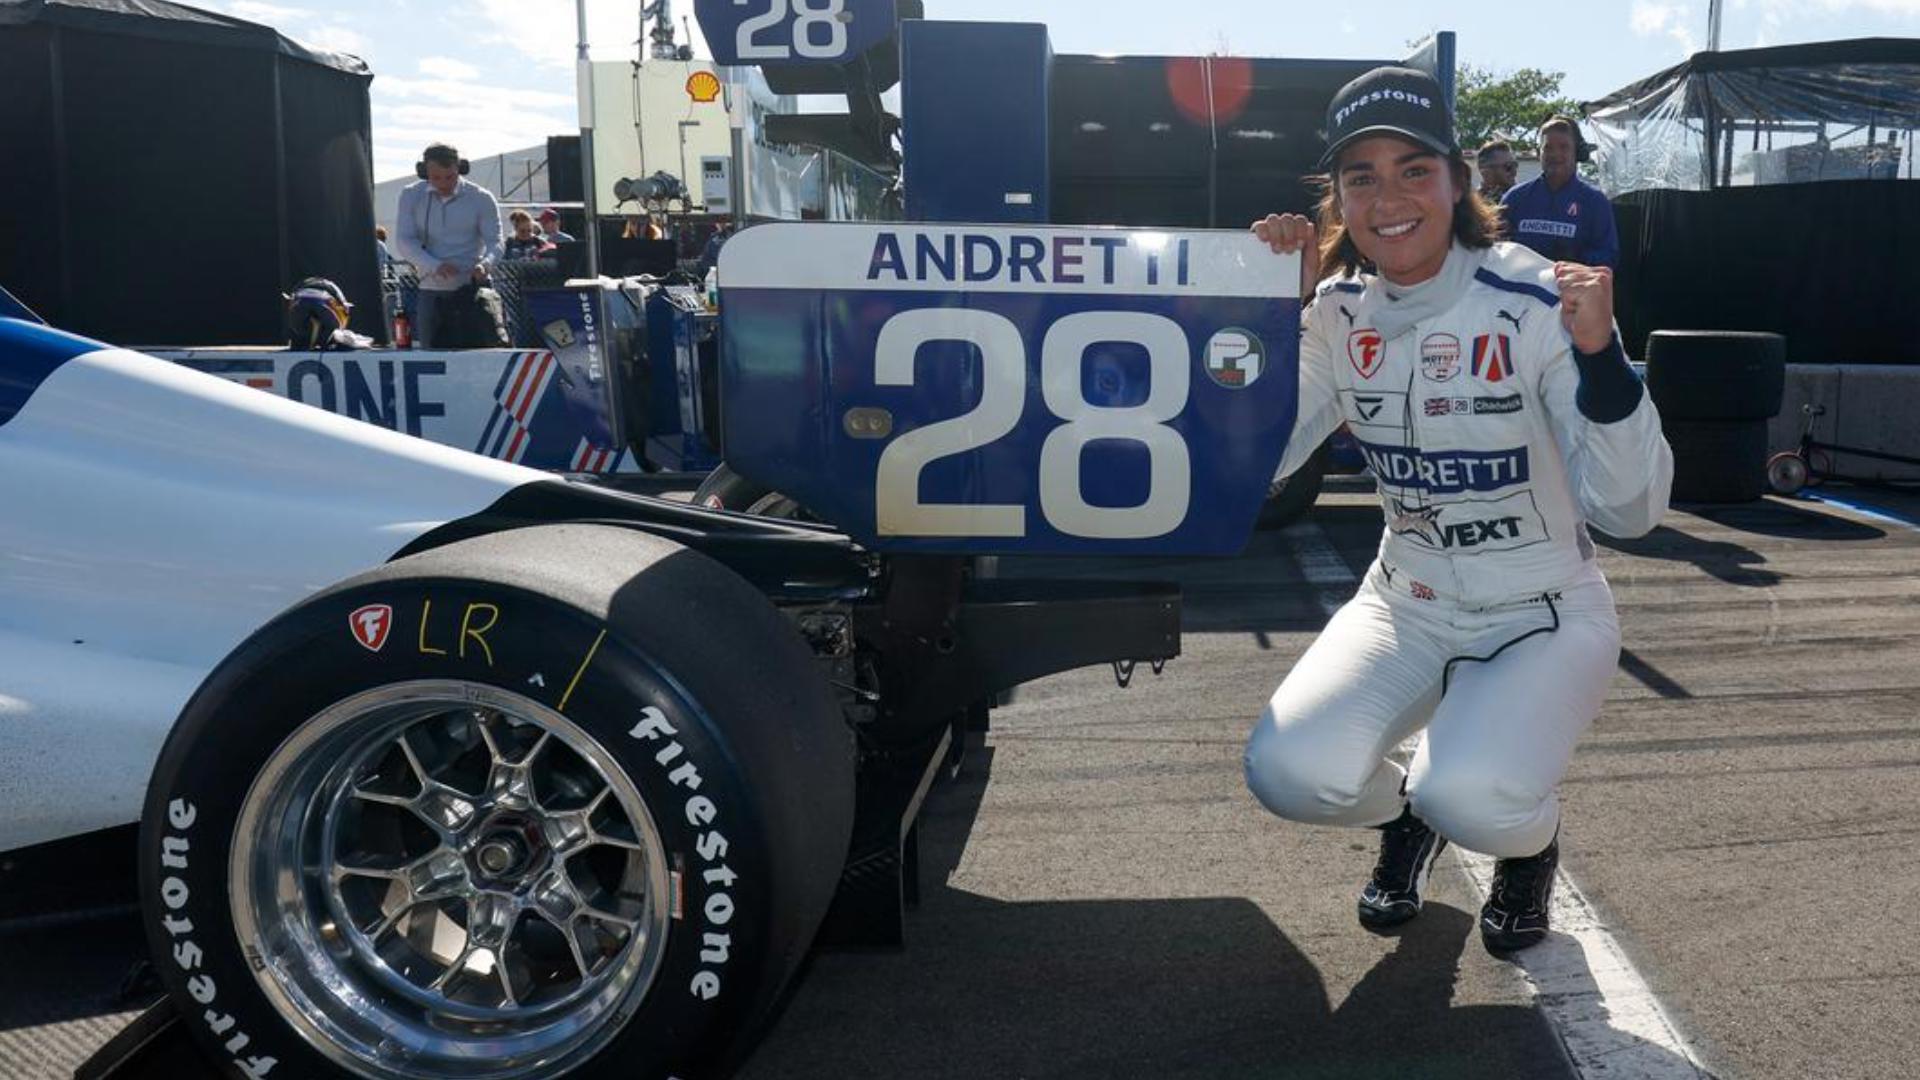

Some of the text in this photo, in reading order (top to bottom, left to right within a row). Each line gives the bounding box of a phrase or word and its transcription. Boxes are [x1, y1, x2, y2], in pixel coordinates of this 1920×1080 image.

[735, 0, 848, 58] 28
[1335, 88, 1431, 127] Firestone
[579, 292, 601, 380] Firestone
[874, 307, 1191, 539] 28
[1371, 450, 1518, 487] NDRETTI
[1434, 516, 1522, 548] VEXT
[628, 705, 738, 1001] Firestone
[161, 797, 278, 1080] Firestone
